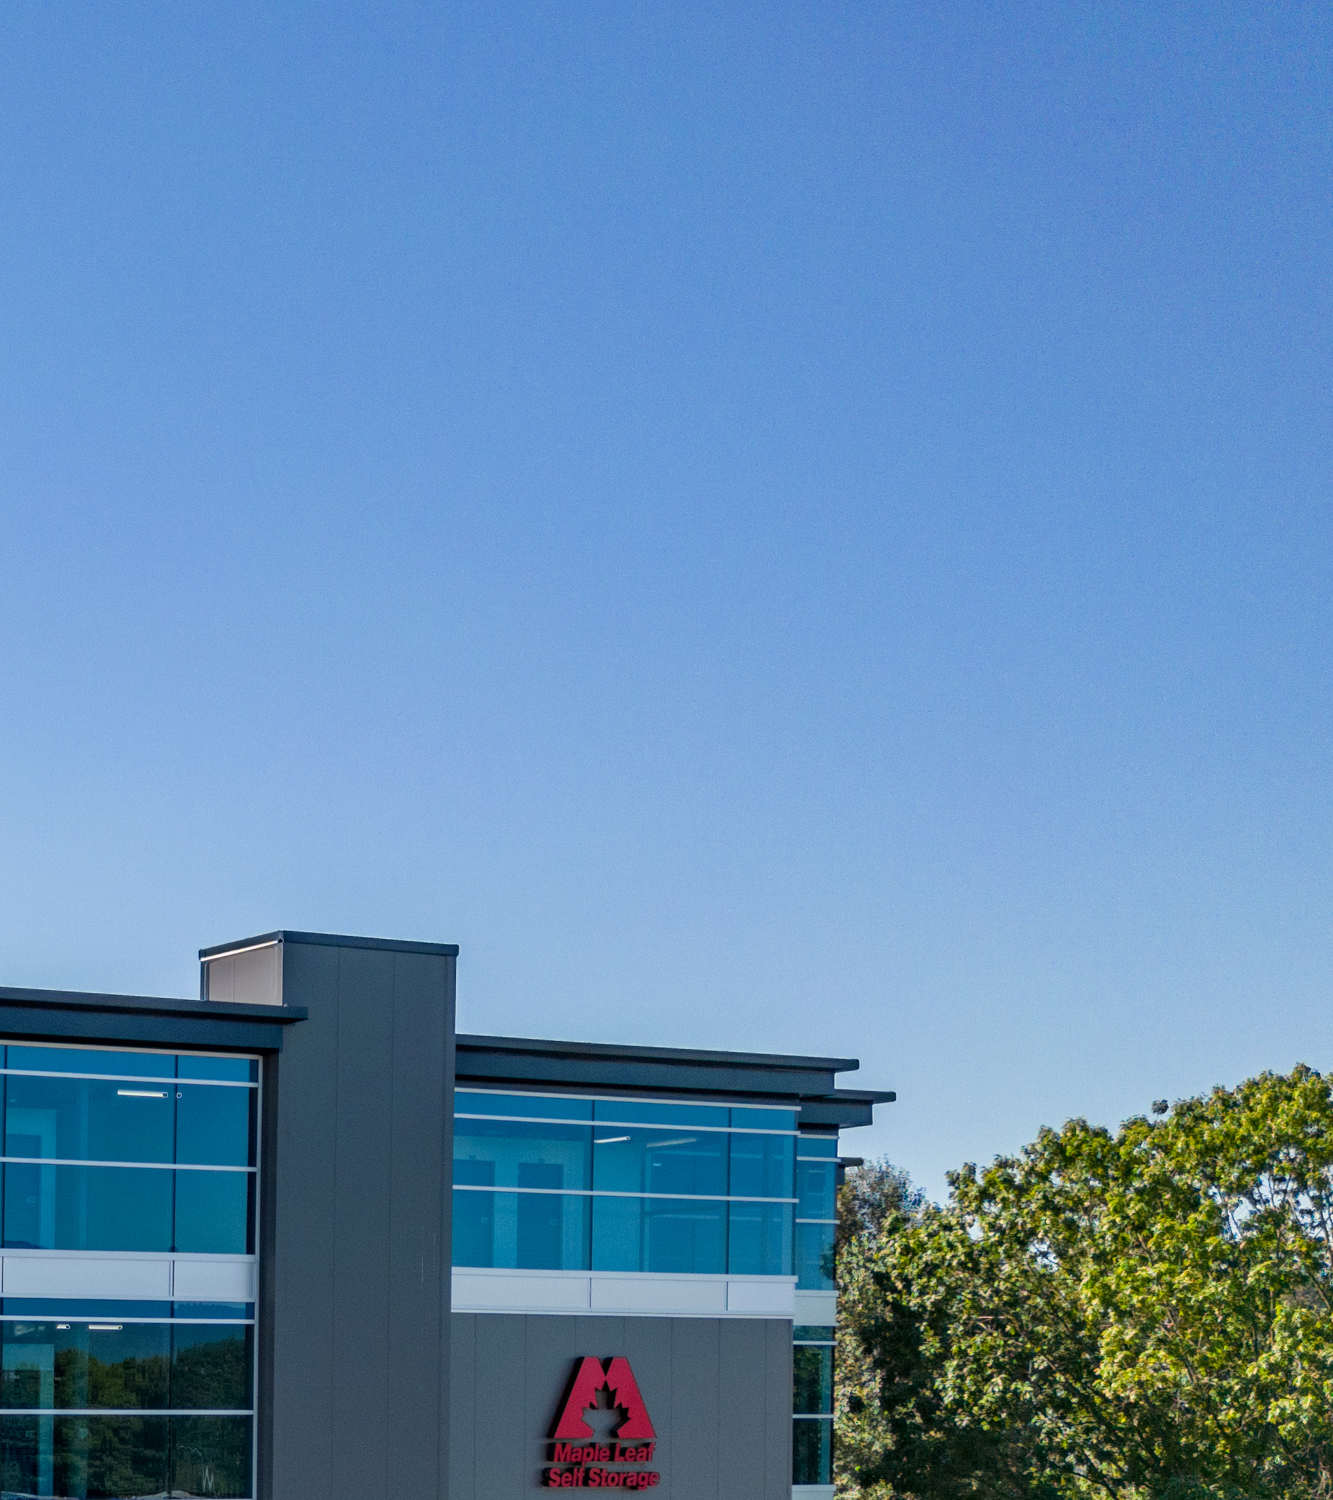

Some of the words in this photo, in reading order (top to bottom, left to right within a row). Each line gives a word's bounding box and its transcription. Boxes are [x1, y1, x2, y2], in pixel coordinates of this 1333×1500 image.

[553, 1442, 611, 1466] Maple
[614, 1442, 656, 1462] Leaf
[548, 1467, 585, 1487] Self
[588, 1467, 660, 1490] Storage
